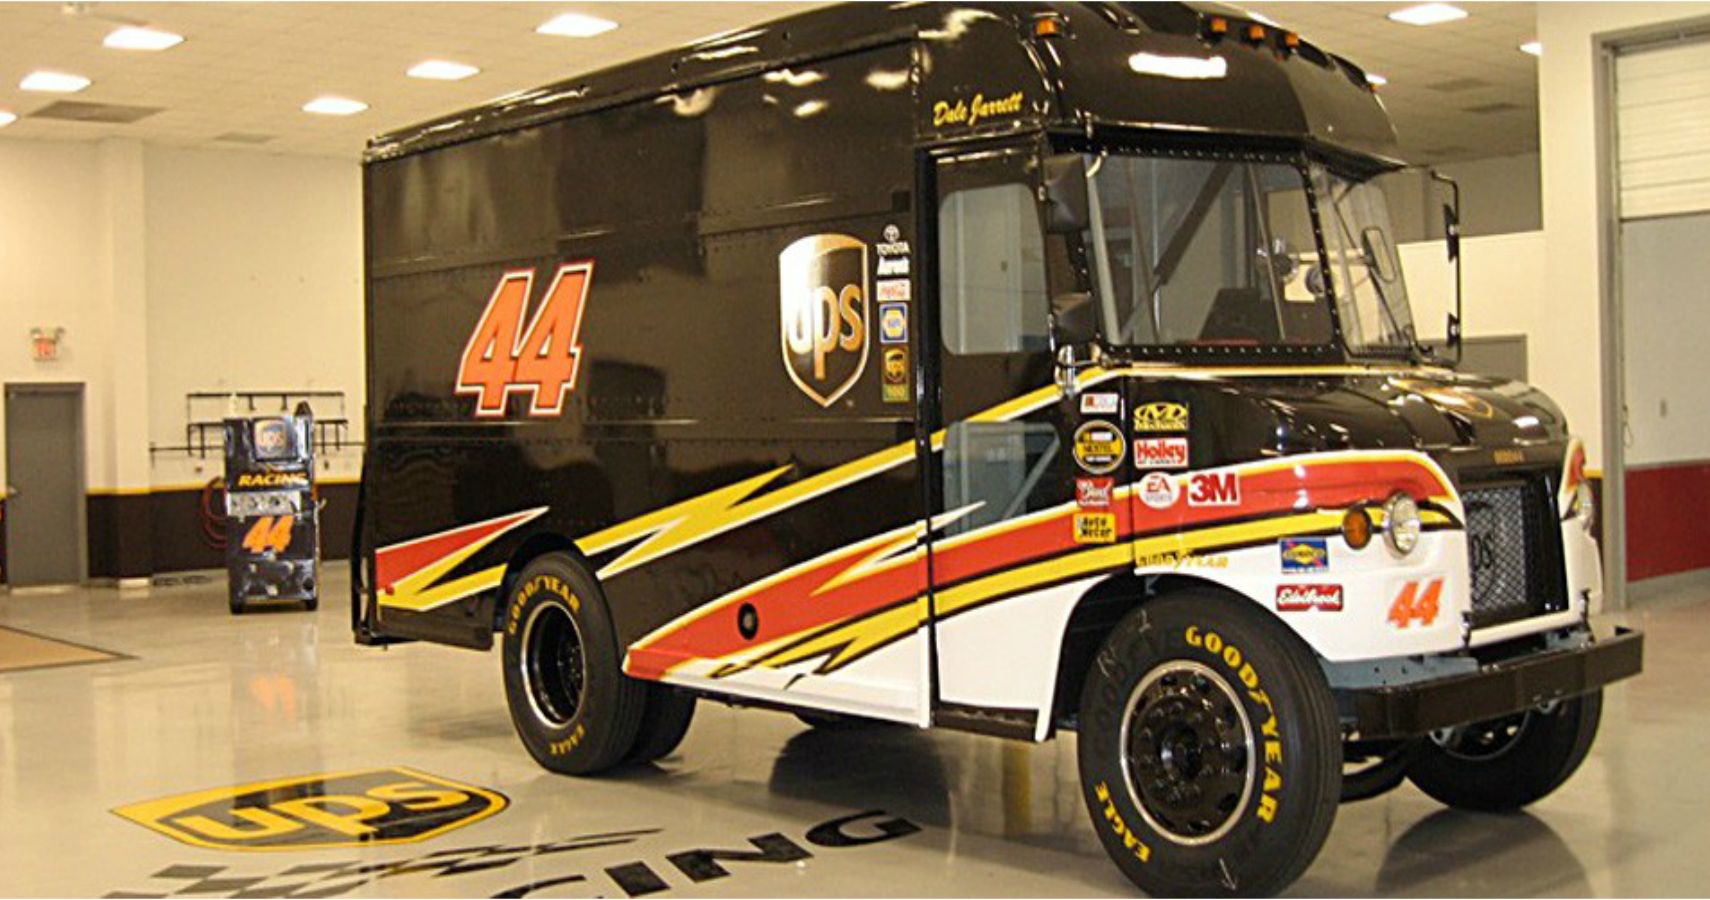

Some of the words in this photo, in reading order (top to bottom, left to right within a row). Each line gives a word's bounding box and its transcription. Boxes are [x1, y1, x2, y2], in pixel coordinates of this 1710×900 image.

[933, 101, 967, 126] Dale
[455, 259, 595, 416] 44
[1136, 440, 1185, 464] Holley
[1190, 473, 1237, 503] 3M
[242, 514, 295, 554] 44
[508, 575, 581, 635] GOODYEAR
[1387, 576, 1445, 628] 44
[1185, 625, 1283, 824] GOODYEAR
[1095, 780, 1150, 863] EAGLE
